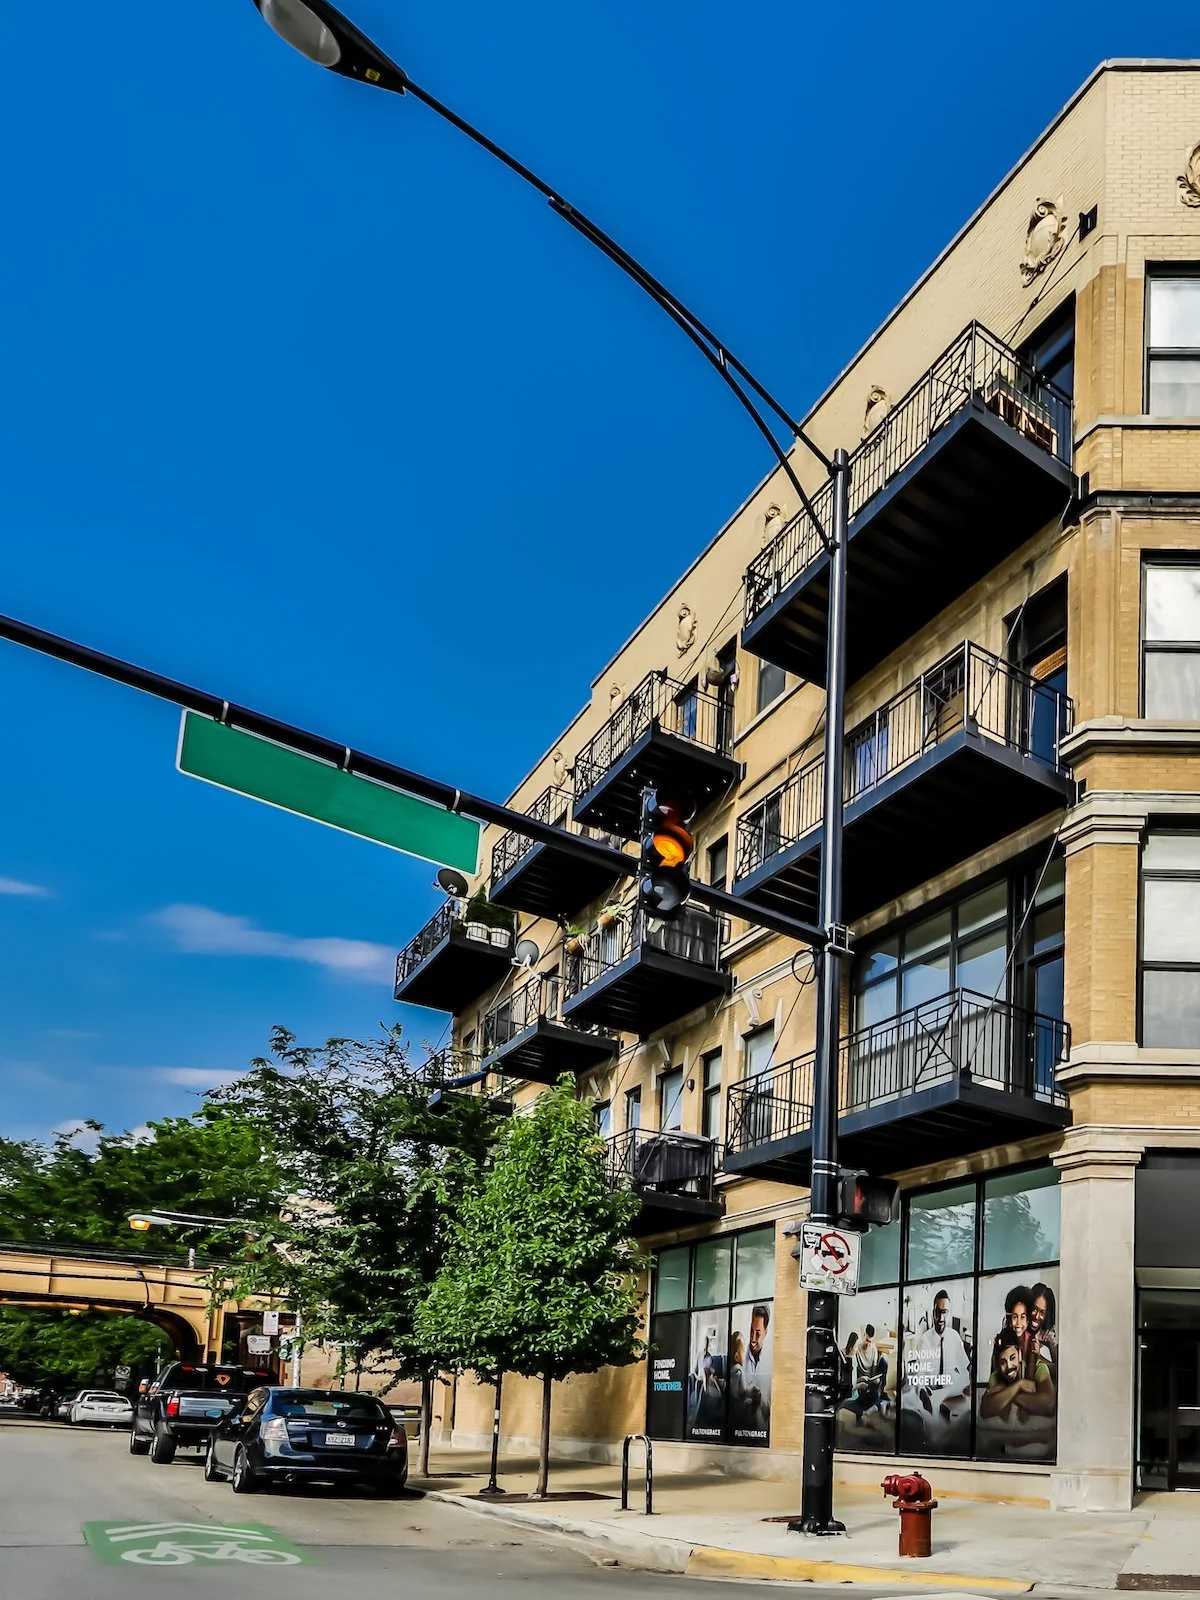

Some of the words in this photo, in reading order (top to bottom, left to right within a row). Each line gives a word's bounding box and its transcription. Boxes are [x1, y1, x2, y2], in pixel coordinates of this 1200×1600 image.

[907, 1349, 941, 1360] FINDING
[654, 1359, 675, 1369] FINDING
[907, 1362, 934, 1373] HOME,
[907, 1375, 954, 1386] TOGETHER.
[654, 1382, 682, 1391] TOGETHER.
[735, 1430, 767, 1438] FULTONGRACE
